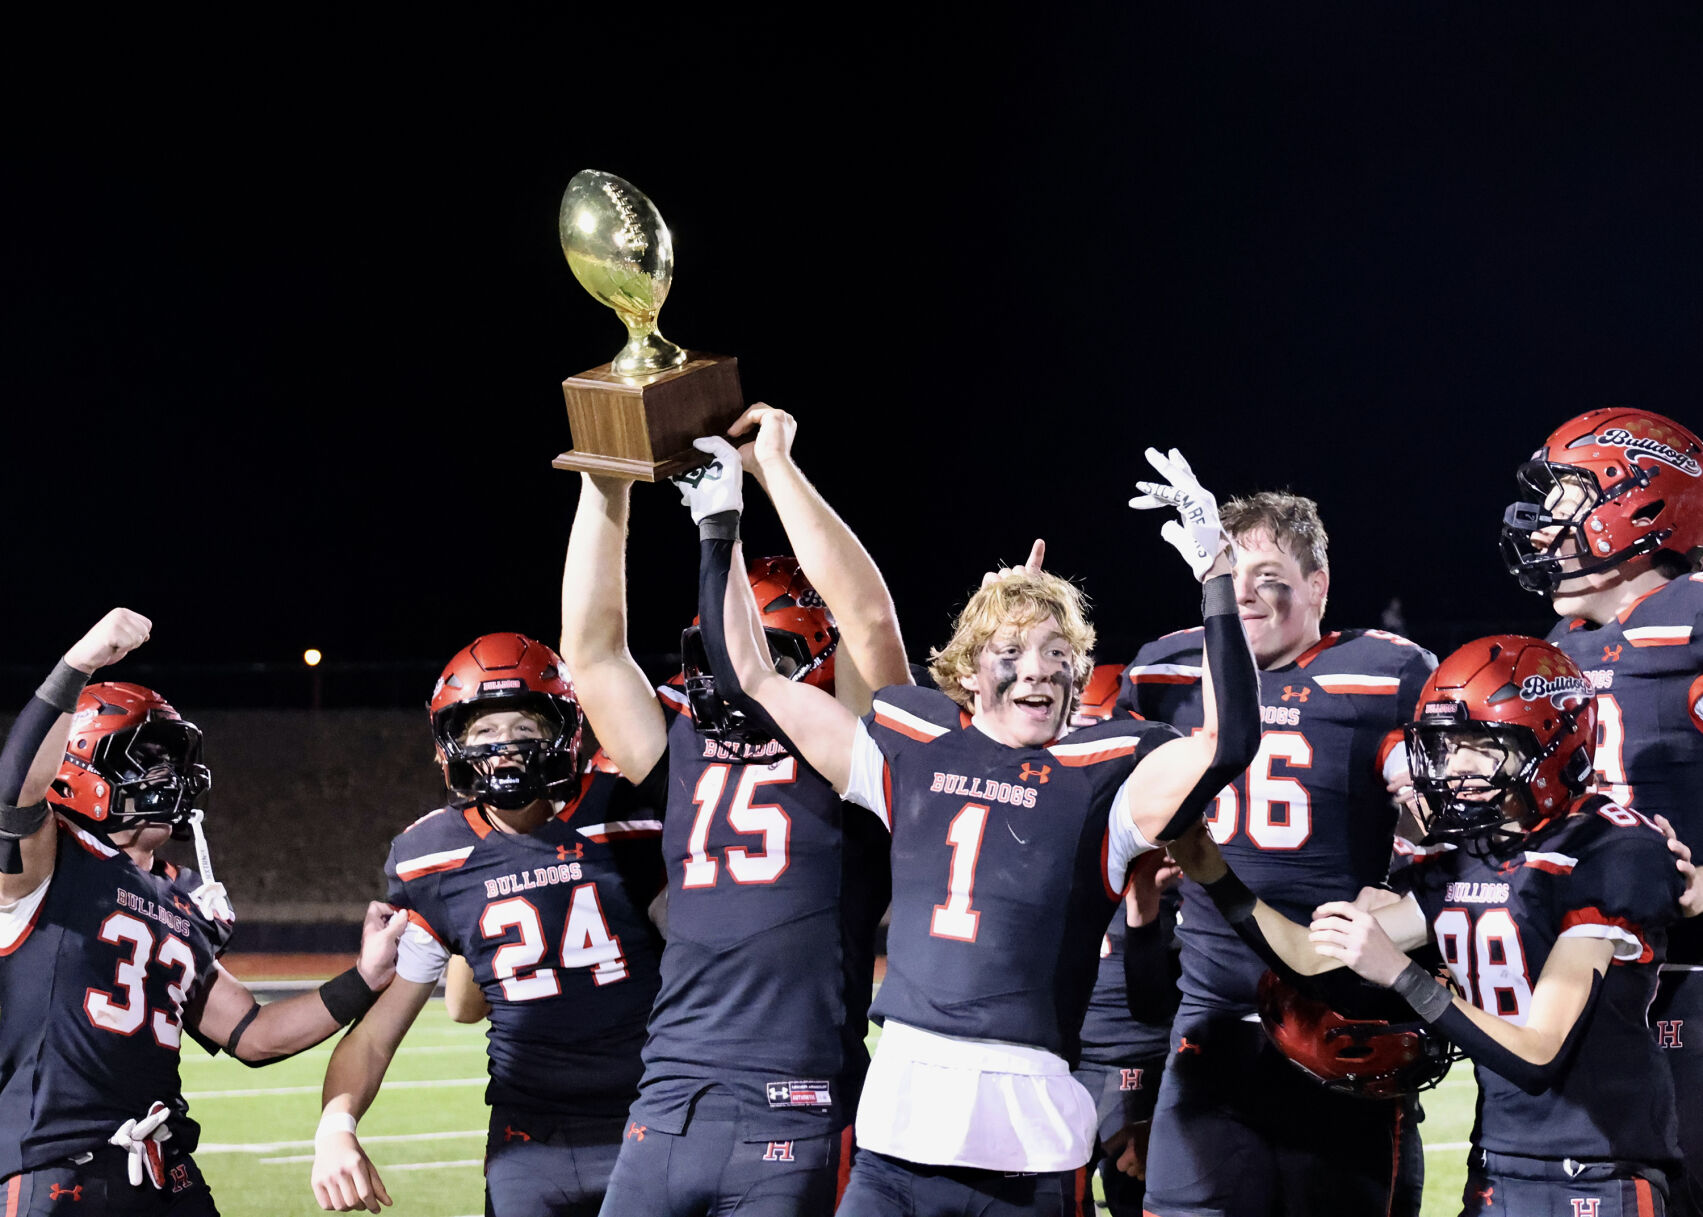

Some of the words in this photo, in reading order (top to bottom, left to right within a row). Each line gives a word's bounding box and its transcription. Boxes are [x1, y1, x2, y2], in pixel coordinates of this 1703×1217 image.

[1596, 428, 1702, 476] Bulldogs
[930, 771, 1038, 808] BULLDOGS
[682, 756, 797, 889] 15
[484, 862, 583, 899] BULLDOGS
[929, 802, 990, 943] 1
[1444, 881, 1510, 903] BULLDOGS
[117, 887, 191, 937] BULLDOGS
[479, 882, 630, 1002] 24
[83, 910, 196, 1052] 33
[1119, 1068, 1144, 1091] H
